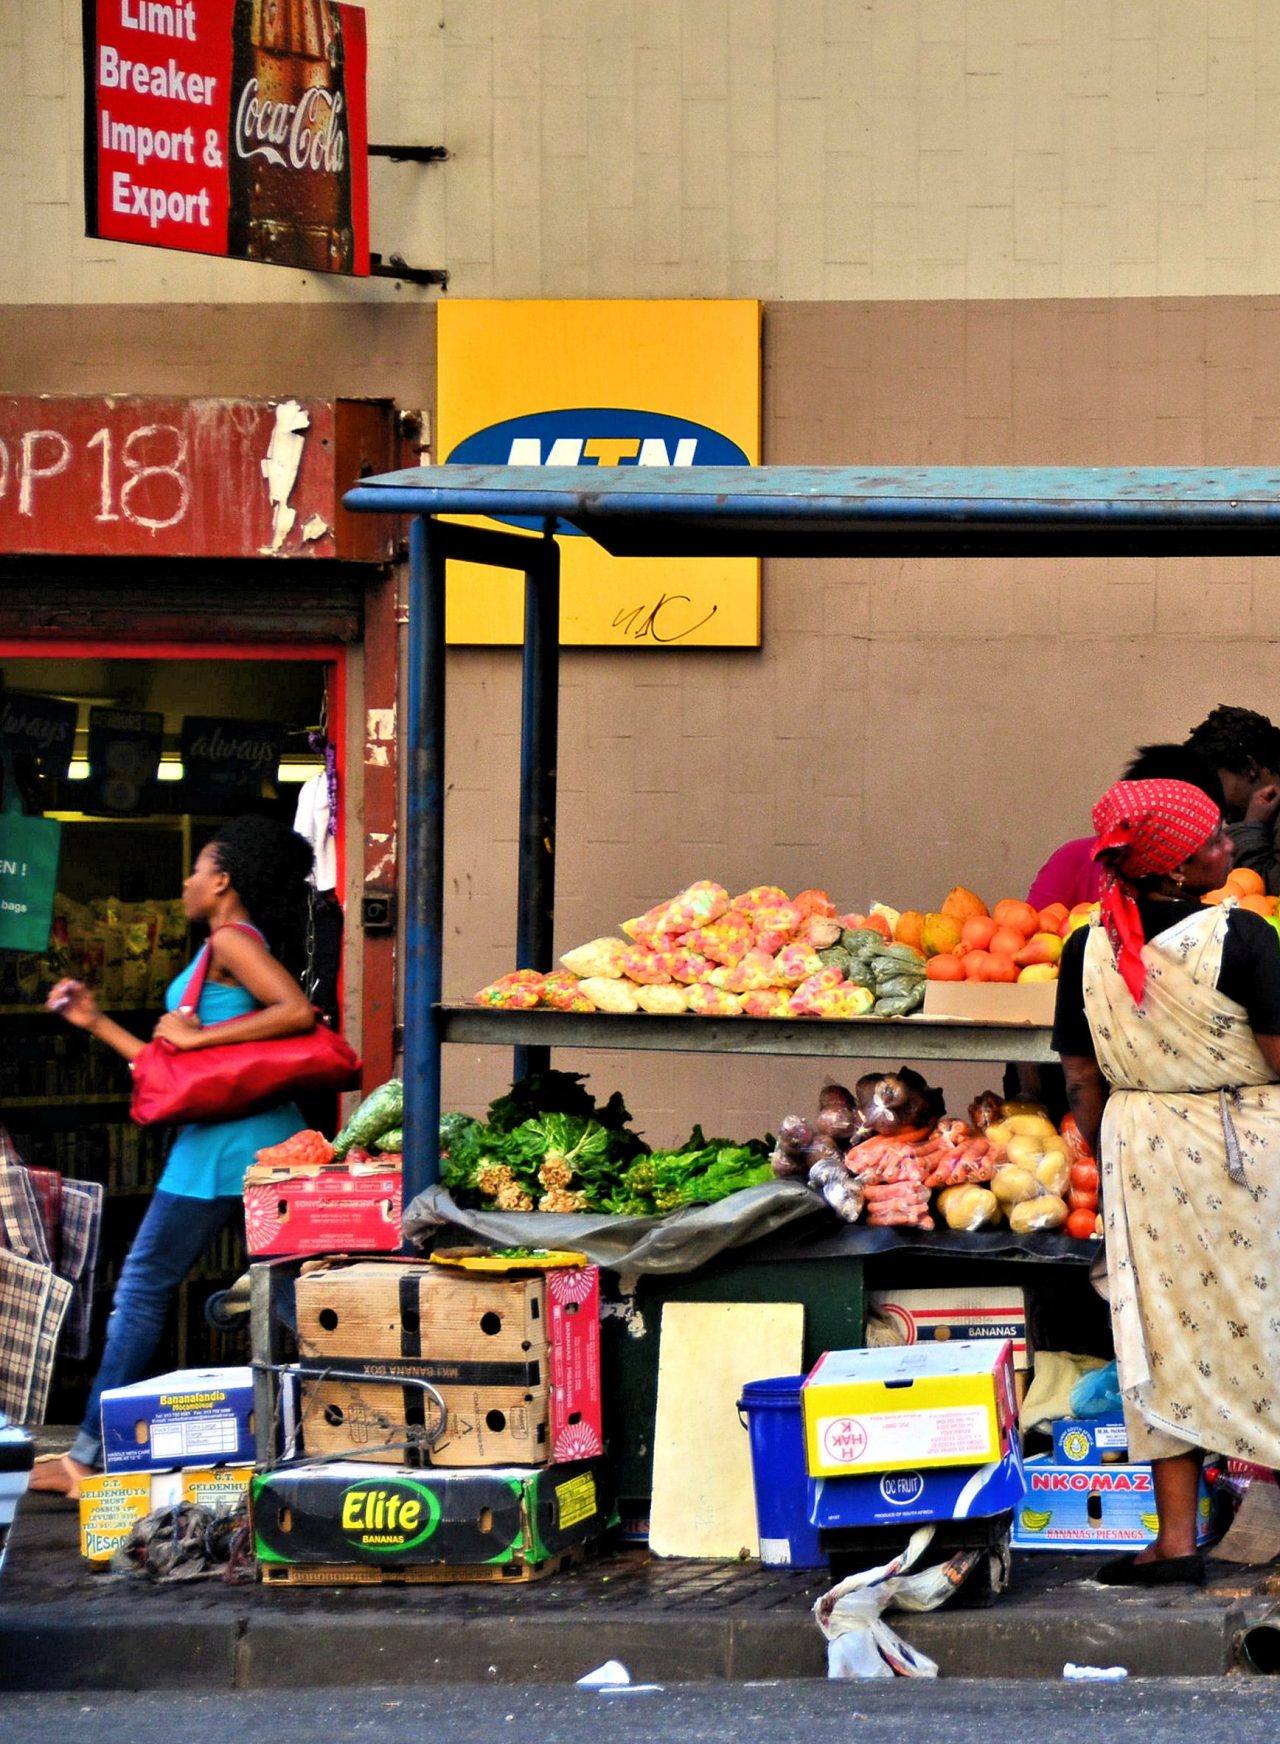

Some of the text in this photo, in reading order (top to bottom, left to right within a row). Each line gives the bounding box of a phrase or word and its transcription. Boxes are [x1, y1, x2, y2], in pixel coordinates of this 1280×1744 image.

[120, 0, 197, 41] Limit
[100, 45, 216, 105] Breaker
[101, 110, 223, 168] Import &
[112, 171, 210, 228] Export
[1, 901, 28, 913] bags
[968, 1326, 1017, 1337] BANANAS
[363, 1364, 387, 1376] BOX
[160, 1391, 226, 1406] Bananalandia
[841, 1422, 852, 1433] K
[833, 1434, 863, 1447] HAK
[842, 1447, 853, 1459] H
[214, 1473, 234, 1482] G.T.
[188, 1482, 247, 1492] GELDENHU
[897, 1477, 918, 1494] FRUIT
[80, 1488, 146, 1498] GELDENHUYS
[100, 1497, 125, 1505] TRUST
[341, 1491, 421, 1530] Elite
[362, 1535, 405, 1544] BANANAS
[1046, 1530, 1145, 1539] BANANAS PIESANGS
